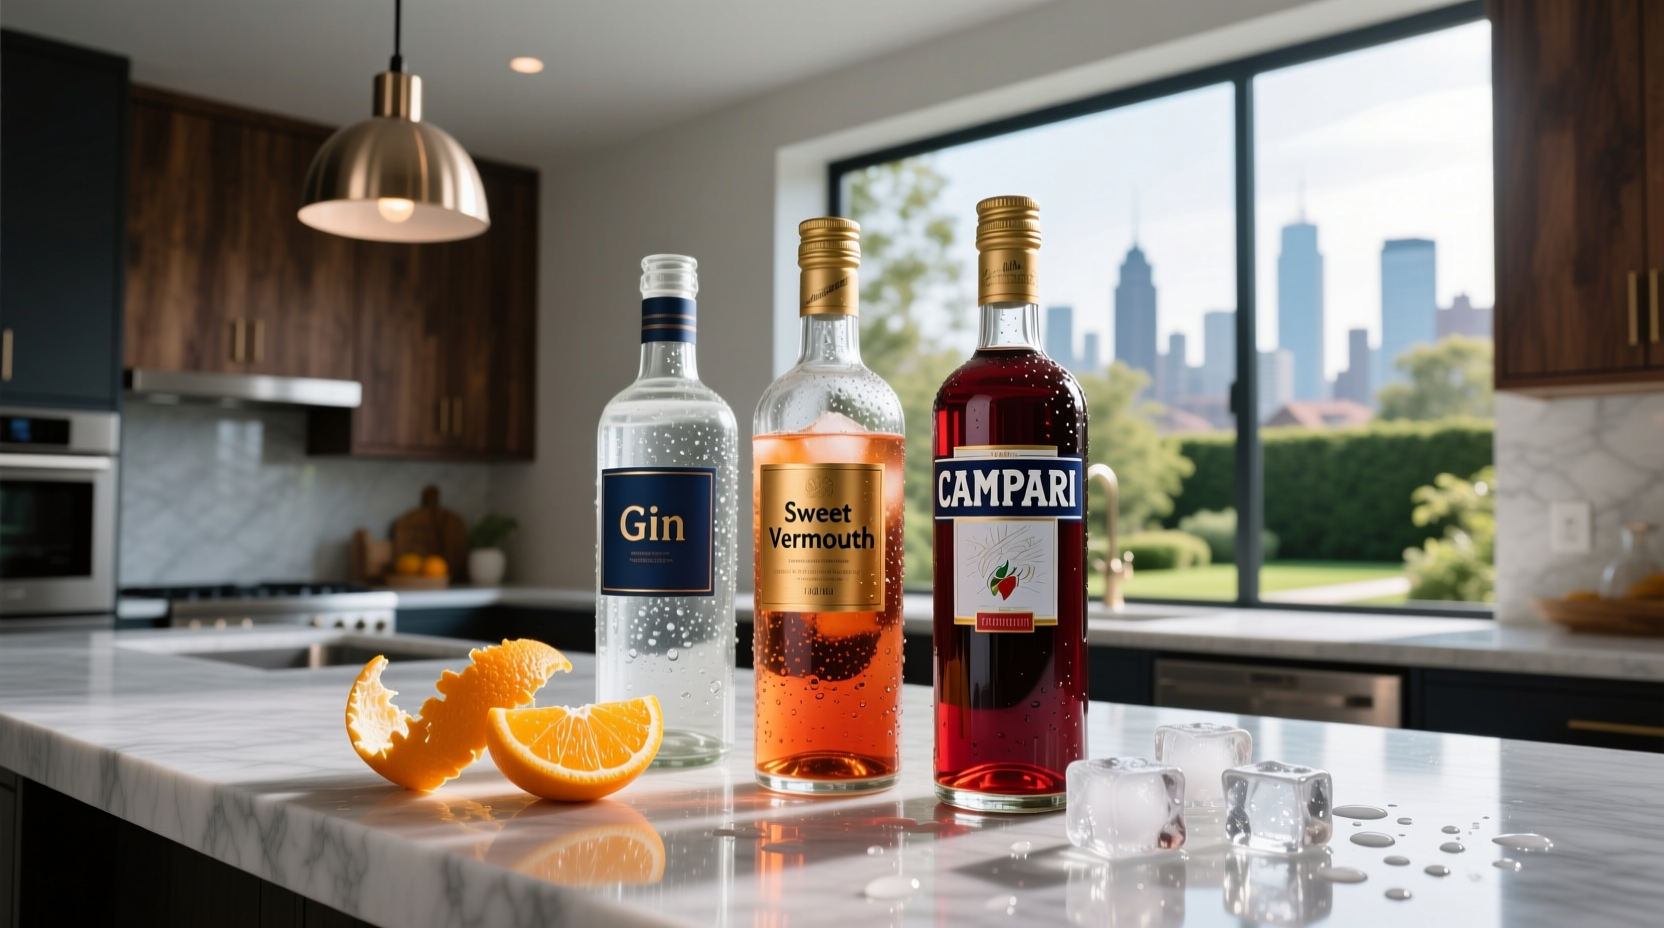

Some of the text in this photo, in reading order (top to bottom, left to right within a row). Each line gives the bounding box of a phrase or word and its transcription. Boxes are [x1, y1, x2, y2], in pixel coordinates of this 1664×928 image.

[938, 469, 1076, 508] CAMPARI
[620, 505, 685, 541] Gin
[784, 501, 852, 523] Sweet
[769, 526, 875, 549] Vermouth
